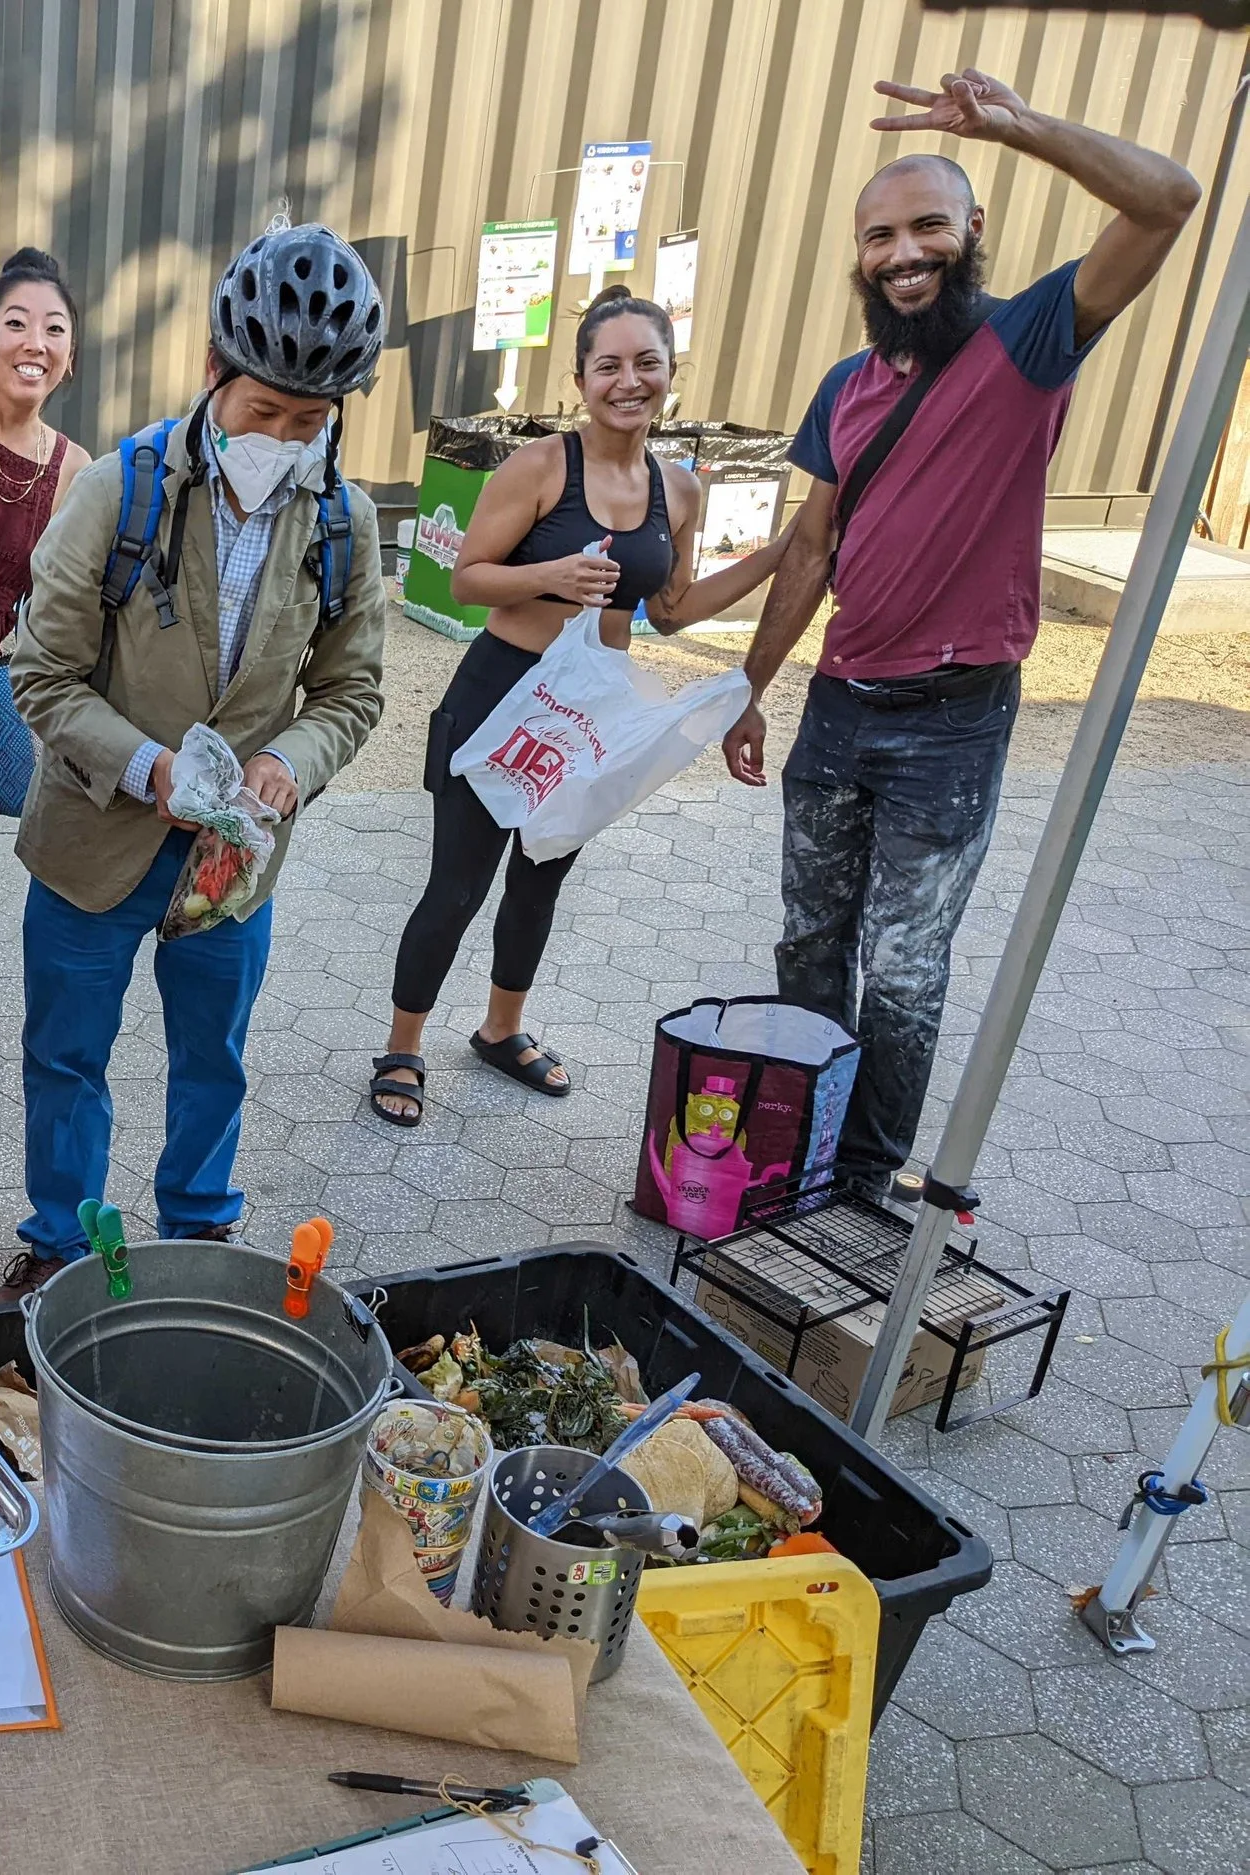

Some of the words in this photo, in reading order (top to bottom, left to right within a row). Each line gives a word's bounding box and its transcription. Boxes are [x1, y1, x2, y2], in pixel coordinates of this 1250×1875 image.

[757, 1101, 793, 1113] perky.
[677, 1185, 710, 1194] TRADER
[683, 1191, 707, 1200] JOE'S
[573, 1564, 585, 1580] Dole
